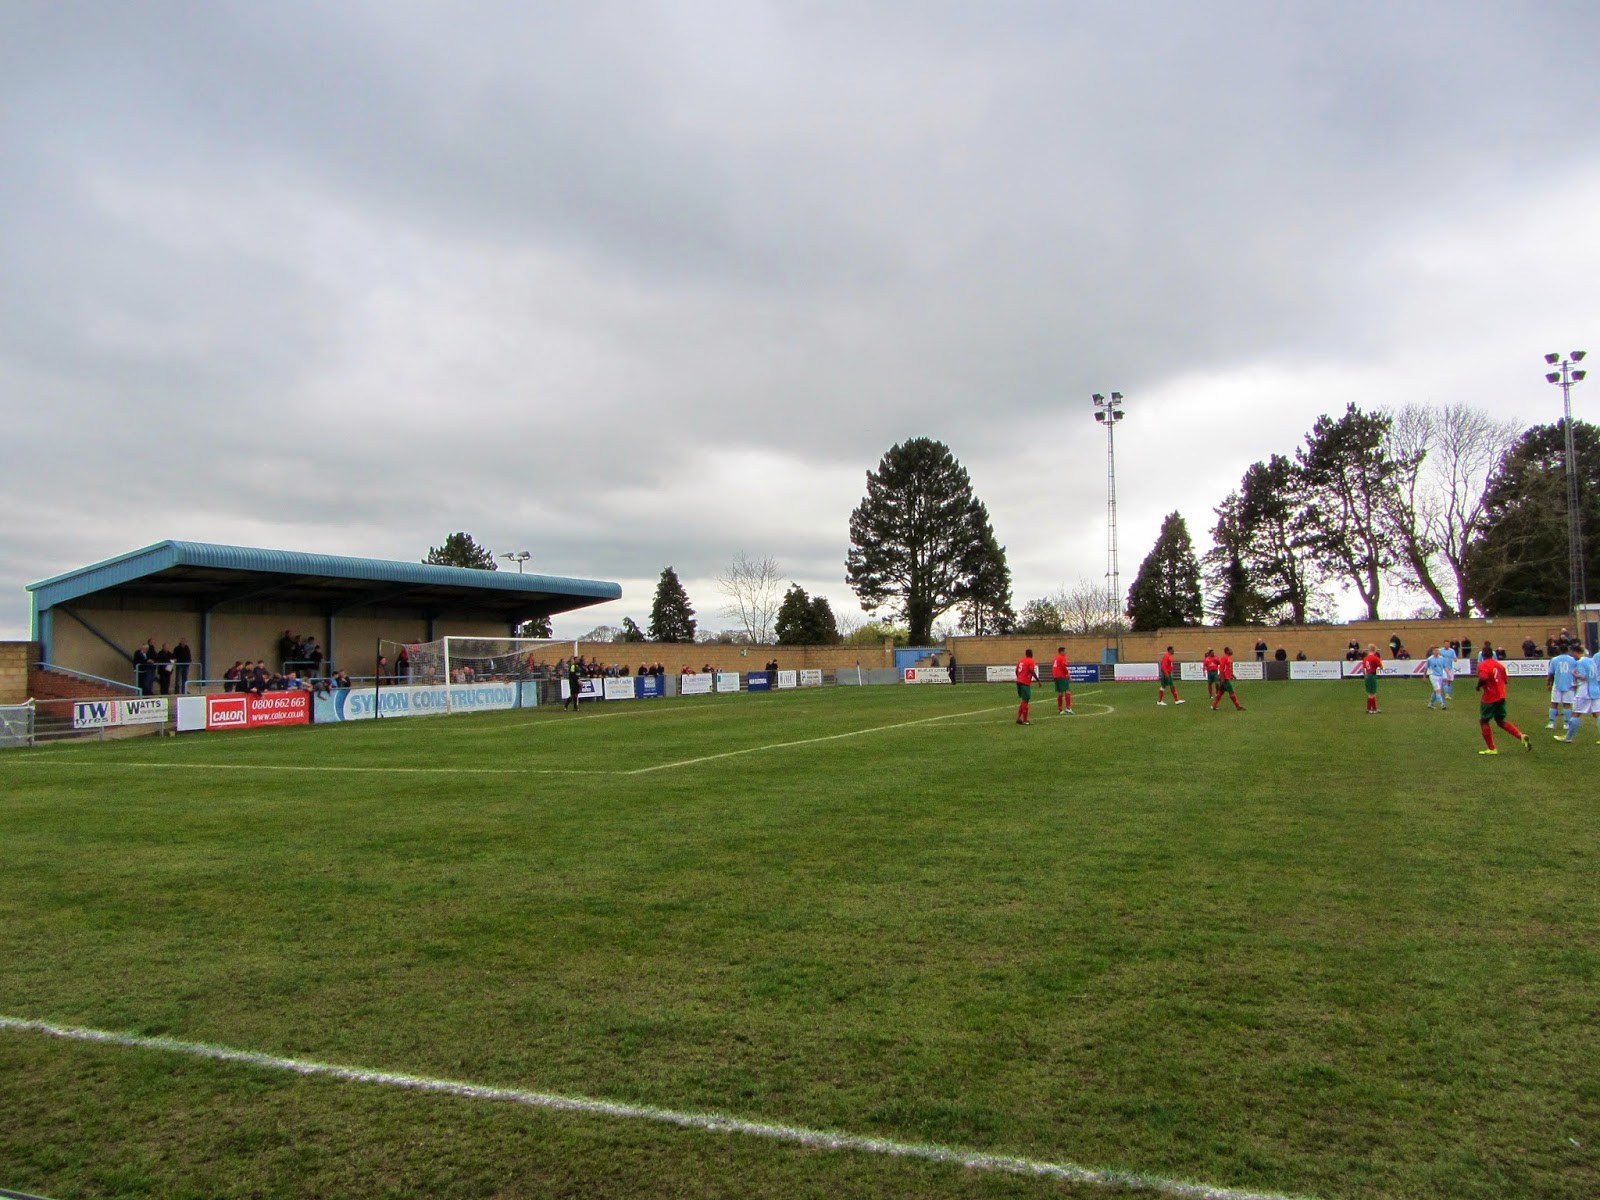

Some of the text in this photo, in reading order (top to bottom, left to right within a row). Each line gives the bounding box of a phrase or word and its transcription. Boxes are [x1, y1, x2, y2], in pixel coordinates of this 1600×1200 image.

[1018, 662, 1024, 672] 5
[1559, 661, 1568, 673] 10
[1492, 667, 1499, 682] 2
[252, 697, 306, 710] 0800 662 663
[350, 688, 512, 714] SYMON CONSTRUCTION
[74, 703, 109, 719] TW
[126, 700, 161, 715] WATTS
[75, 717, 109, 725] tyres
[212, 710, 244, 722] CALOR
[251, 710, 304, 722] www.calor.co.uk
